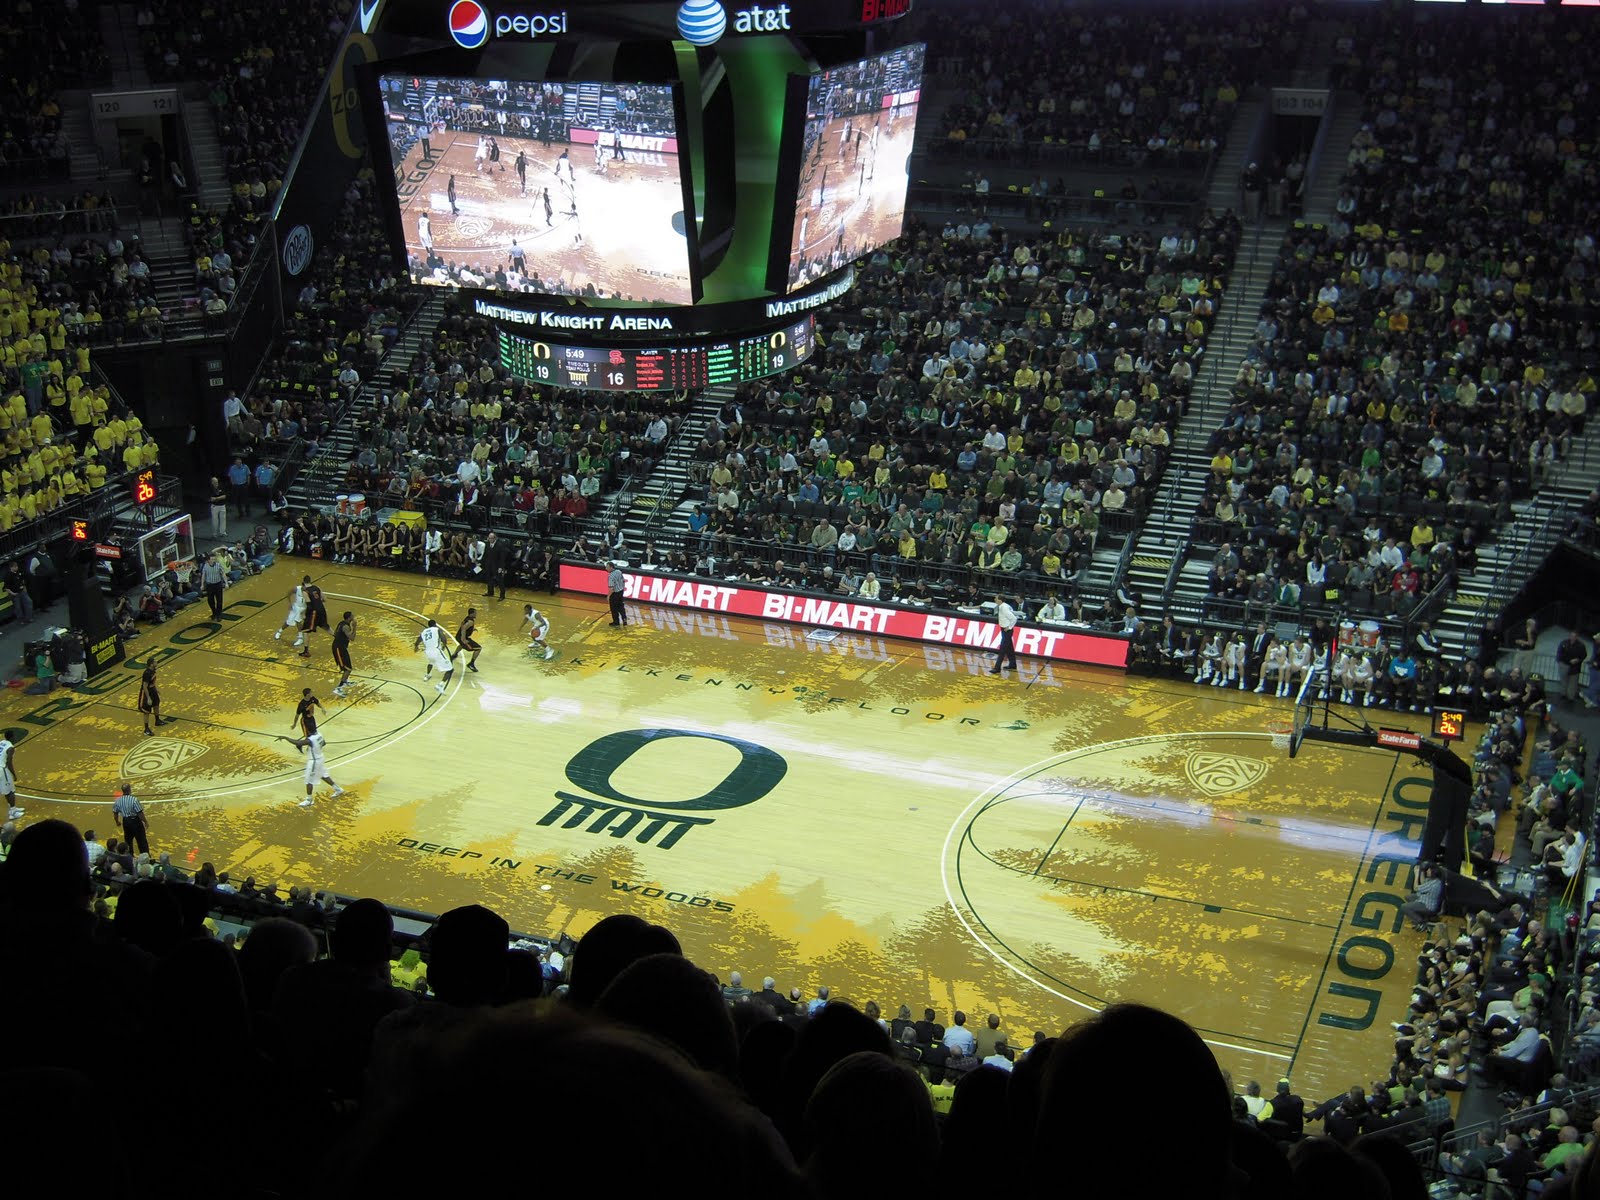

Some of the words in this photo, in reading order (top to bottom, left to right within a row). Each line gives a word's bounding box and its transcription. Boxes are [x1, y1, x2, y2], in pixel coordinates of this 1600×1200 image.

[495, 11, 568, 38] pepsi
[733, 4, 792, 32] at&t
[98, 102, 120, 112] 120
[598, 131, 668, 151] BIMART
[766, 292, 829, 318] MATTHEW
[475, 300, 537, 324] MATTHEW
[541, 312, 605, 329] KNIGHT
[610, 315, 673, 330] ARENA
[565, 348, 585, 359] 5:49
[772, 354, 784, 368] 19
[536, 365, 549, 379] 19
[607, 372, 624, 385] 16
[138, 484, 154, 501] 26
[75, 529, 86, 538] 26
[762, 592, 895, 633] BI-MART
[424, 631, 433, 641] 23
[569, 656, 787, 695] KILKENNY
[827, 696, 981, 727] FLOOR
[1441, 711, 1463, 723] 5:49
[1440, 721, 1456, 734] 26
[396, 836, 484, 860] DEEP
[490, 856, 522, 870] IN
[534, 864, 599, 886] THE
[611, 879, 737, 914] WOODS
[1317, 776, 1435, 1032] OREGON
